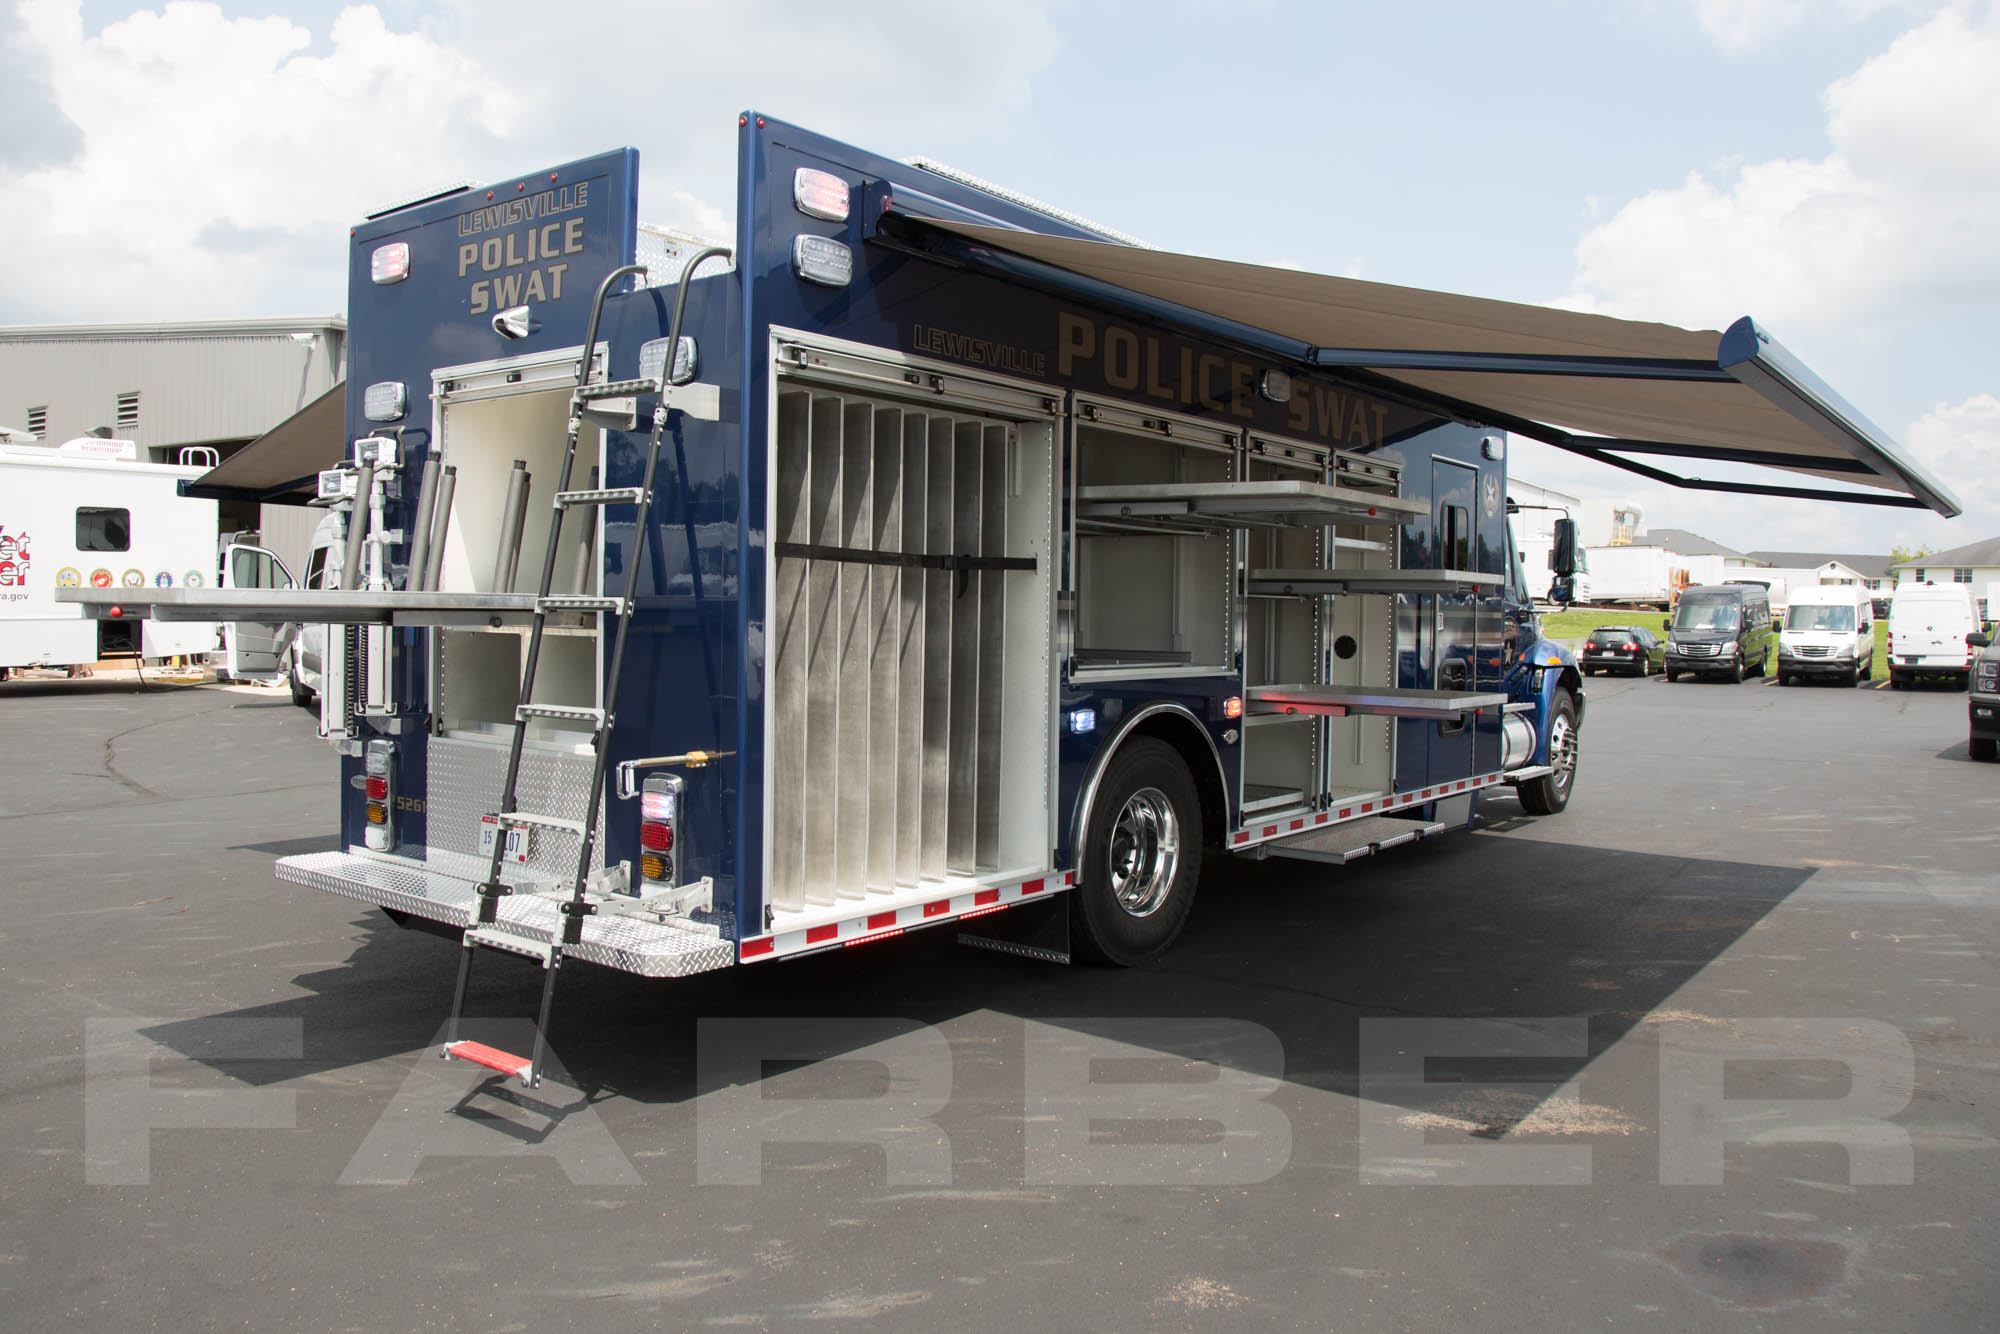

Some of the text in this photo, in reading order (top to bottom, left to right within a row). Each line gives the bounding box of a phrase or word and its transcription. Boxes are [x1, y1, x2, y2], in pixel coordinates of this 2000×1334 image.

[458, 181, 589, 237] LEWISVILLE
[458, 217, 584, 278] POLICE
[470, 263, 568, 315] SWAT
[913, 311, 1389, 450] LEWISVILLE POLICE SWAT
